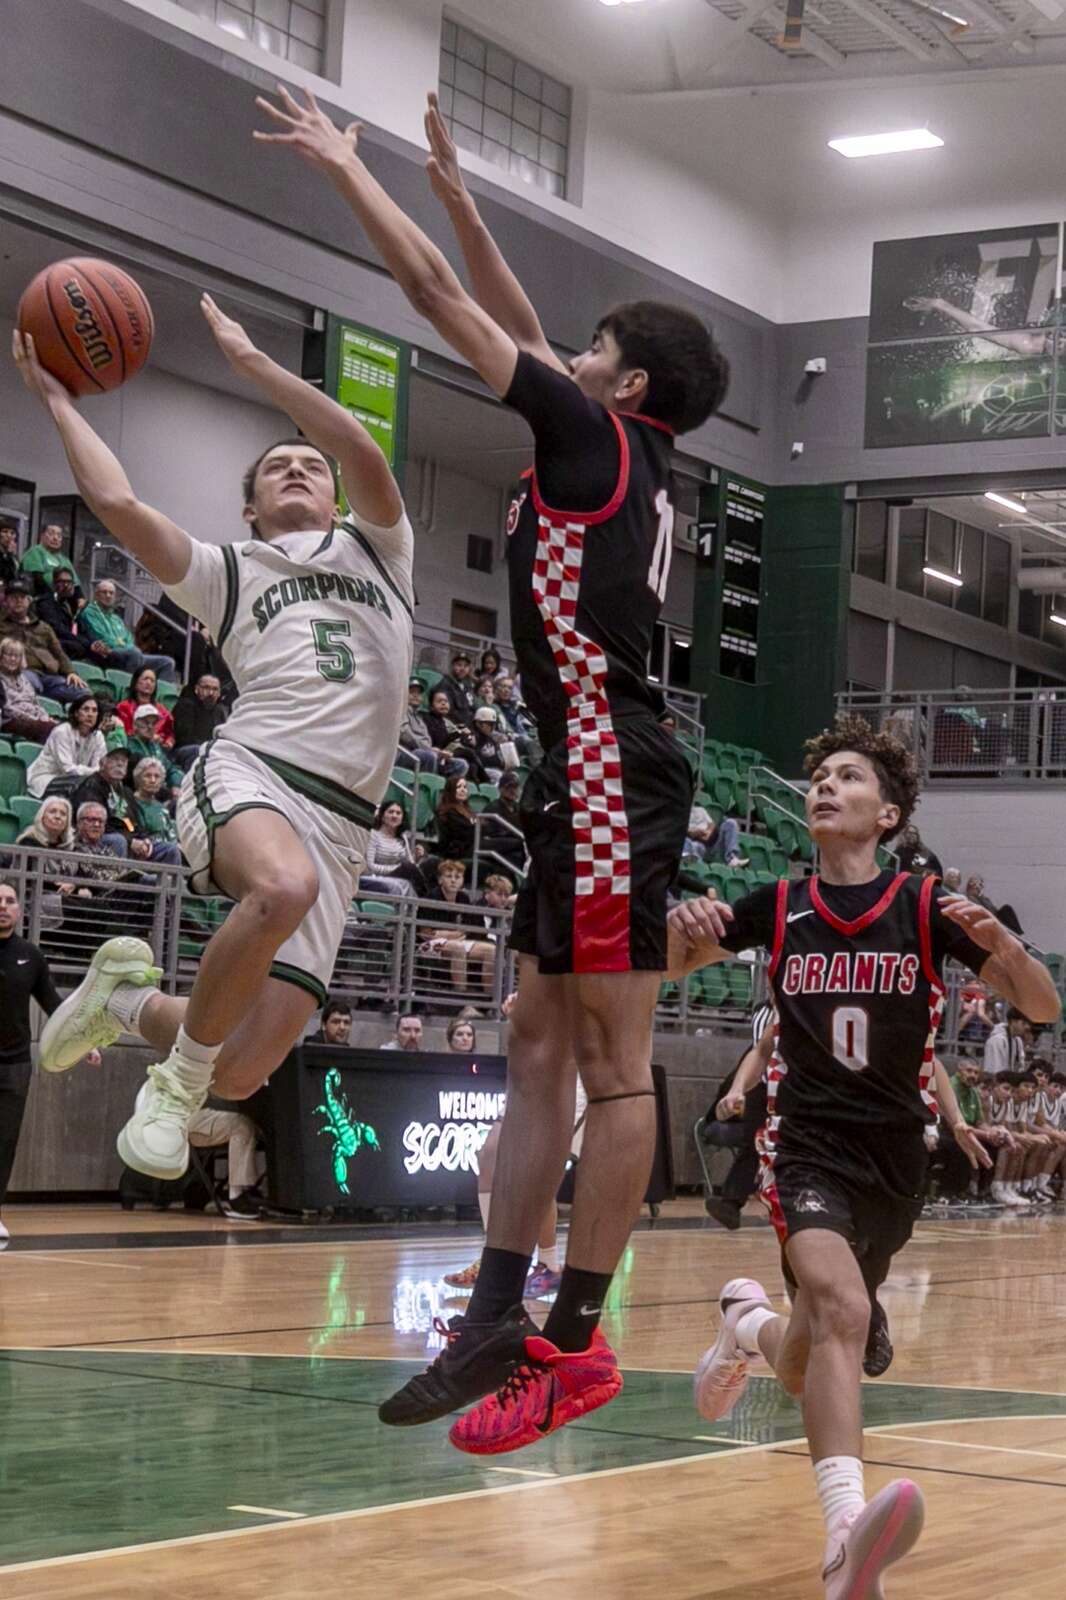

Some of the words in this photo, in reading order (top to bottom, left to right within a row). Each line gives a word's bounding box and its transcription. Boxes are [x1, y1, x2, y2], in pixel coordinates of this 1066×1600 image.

[63, 278, 113, 369] Wilson
[699, 532, 712, 556] 1
[311, 618, 357, 684] 5
[782, 951, 920, 996] GRANTS
[832, 1007, 868, 1071] 0
